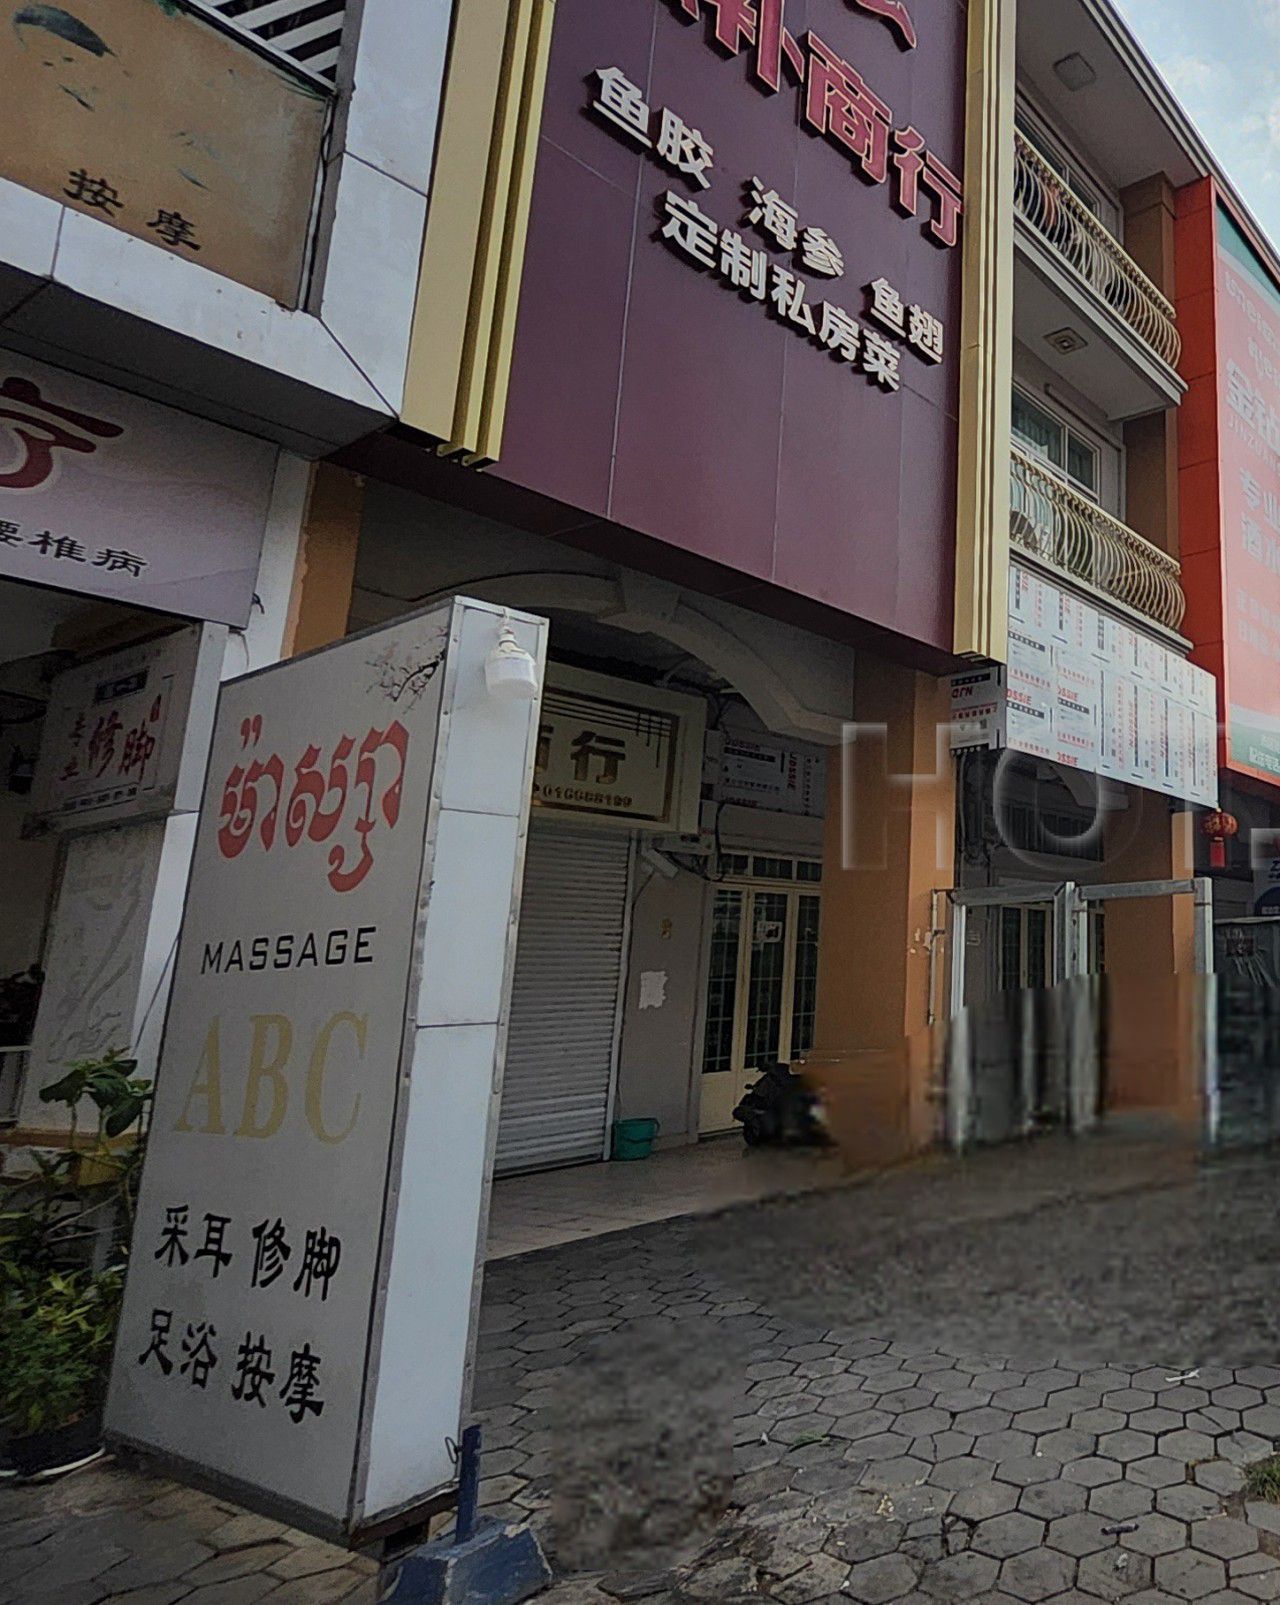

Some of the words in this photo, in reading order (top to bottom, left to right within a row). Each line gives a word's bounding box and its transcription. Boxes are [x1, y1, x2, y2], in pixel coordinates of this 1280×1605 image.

[681, 0, 962, 247] 补商行
[63, 168, 201, 251] 按摩
[591, 66, 713, 190] 鱼胶
[748, 177, 845, 278] 海参
[870, 277, 943, 365] 鱼翅
[662, 190, 901, 392] 定制私房菜
[201, 926, 376, 974] MASSAGE
[176, 1012, 367, 1144] ABC
[154, 1204, 233, 1278] 采耳
[250, 1216, 340, 1301] 修脚
[138, 1308, 218, 1390] 足浴
[231, 1331, 324, 1423] 按摩
